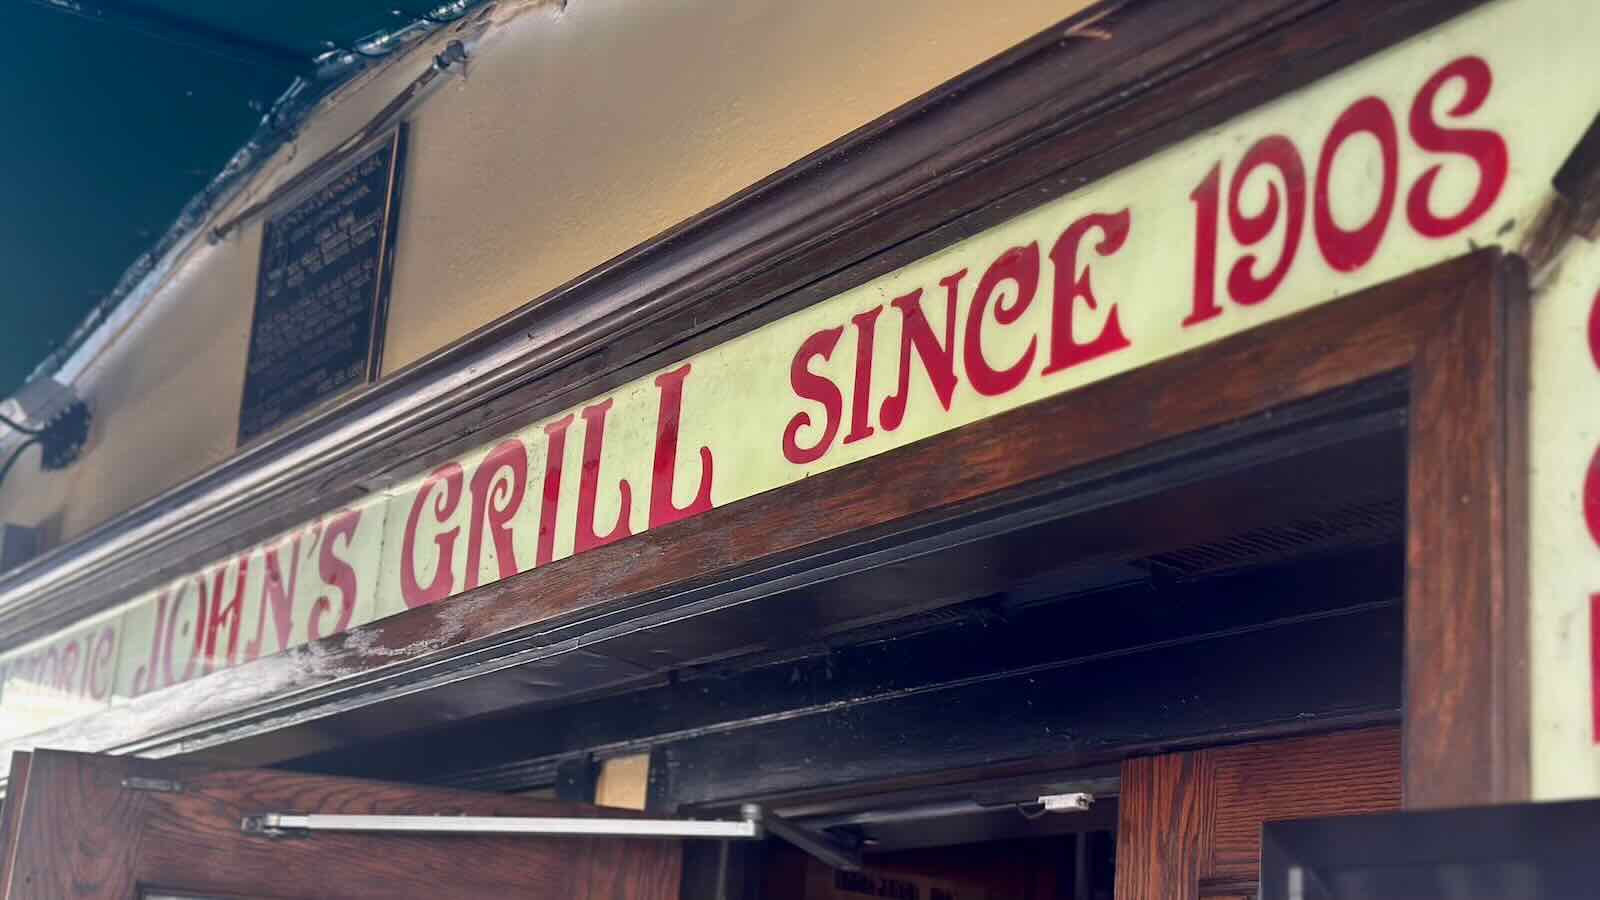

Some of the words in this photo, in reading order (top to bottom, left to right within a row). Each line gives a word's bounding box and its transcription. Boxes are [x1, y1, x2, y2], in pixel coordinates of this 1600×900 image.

[130, 509, 362, 699] JOHN'S
[400, 362, 713, 609] GRILL
[782, 207, 1132, 464] SINCE
